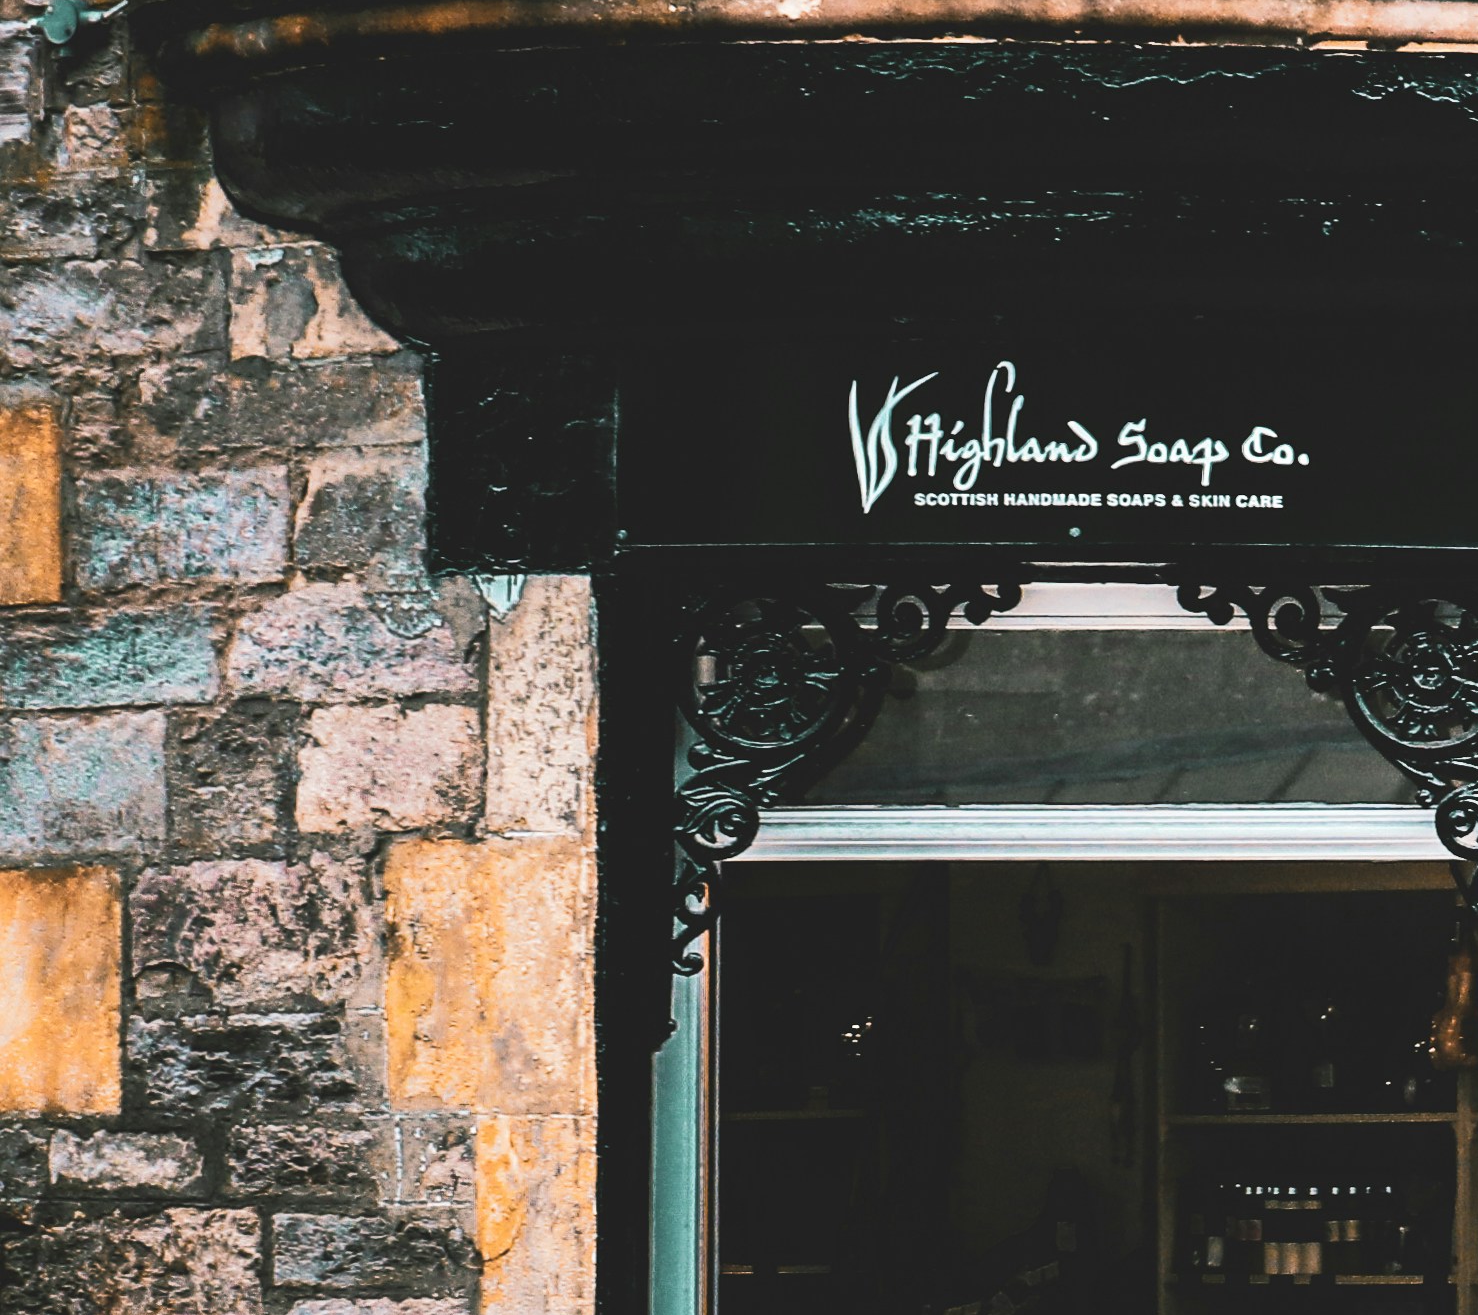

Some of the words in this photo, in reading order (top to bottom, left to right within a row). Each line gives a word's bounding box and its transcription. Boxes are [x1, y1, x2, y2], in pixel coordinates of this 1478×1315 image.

[904, 361, 1098, 491] Highland
[1111, 419, 1229, 486] Soap
[1242, 427, 1309, 465] Co.
[914, 490, 998, 506] SCOTTISH
[1004, 493, 1102, 506] HANDMADE
[1107, 493, 1166, 507] SOAPS
[1171, 495, 1183, 506] &
[1189, 494, 1230, 507] SKIN
[1236, 495, 1283, 508] CARE
